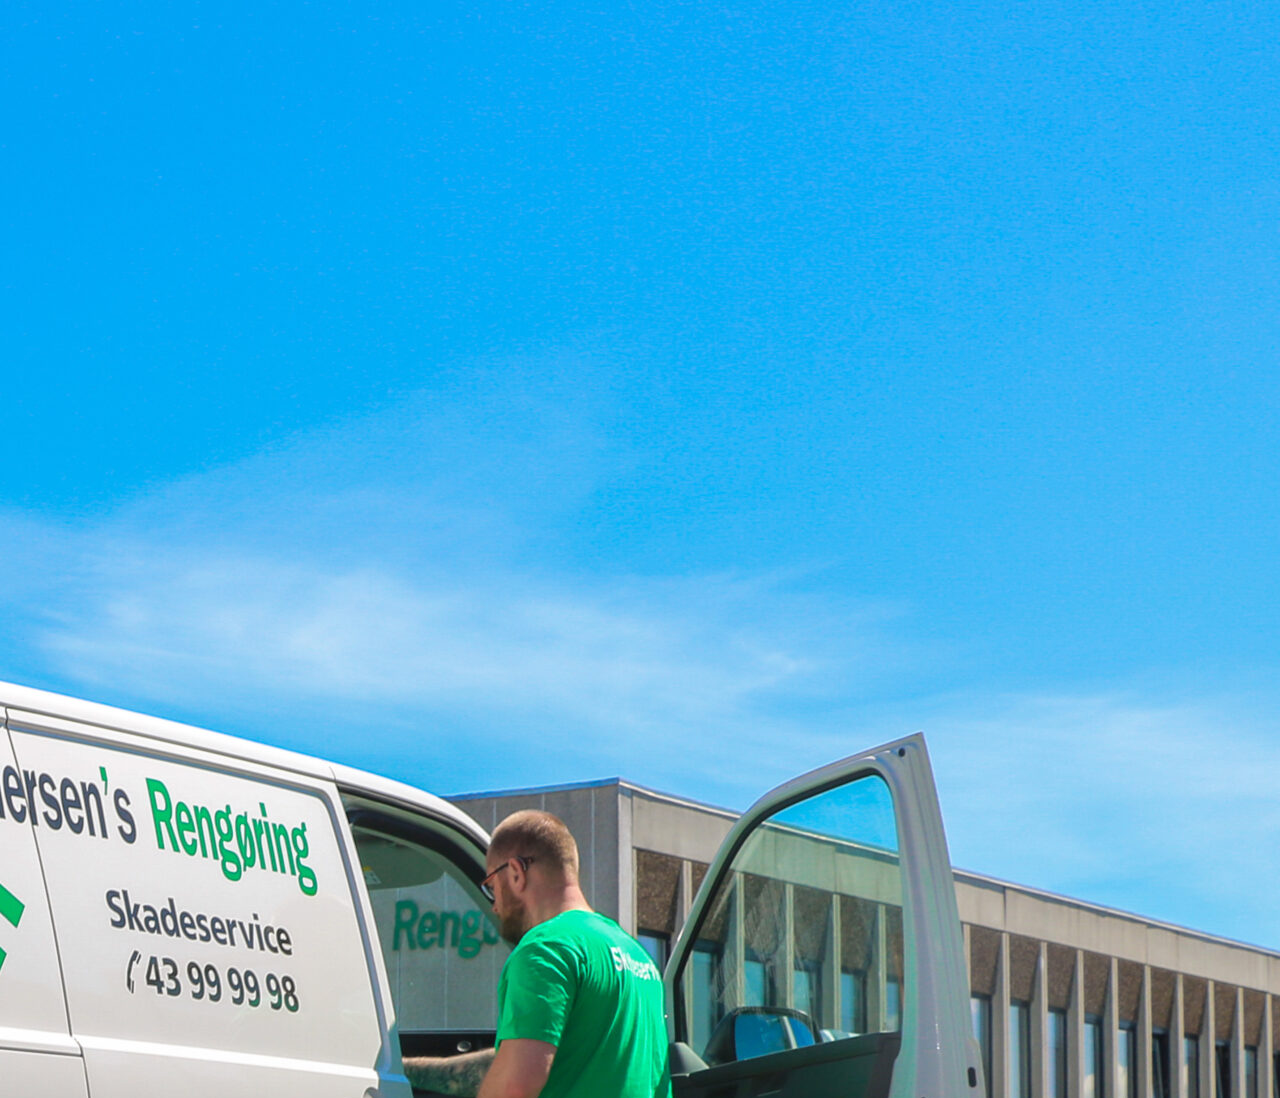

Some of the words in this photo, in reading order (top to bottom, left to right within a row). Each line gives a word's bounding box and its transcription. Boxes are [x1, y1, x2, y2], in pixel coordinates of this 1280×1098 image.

[145, 777, 318, 896] Rengøring
[106, 889, 293, 955] Skadeservice
[145, 955, 182, 996] 43
[186, 961, 222, 1002] 99
[227, 967, 261, 1007] 99
[265, 973, 300, 1012] 98
